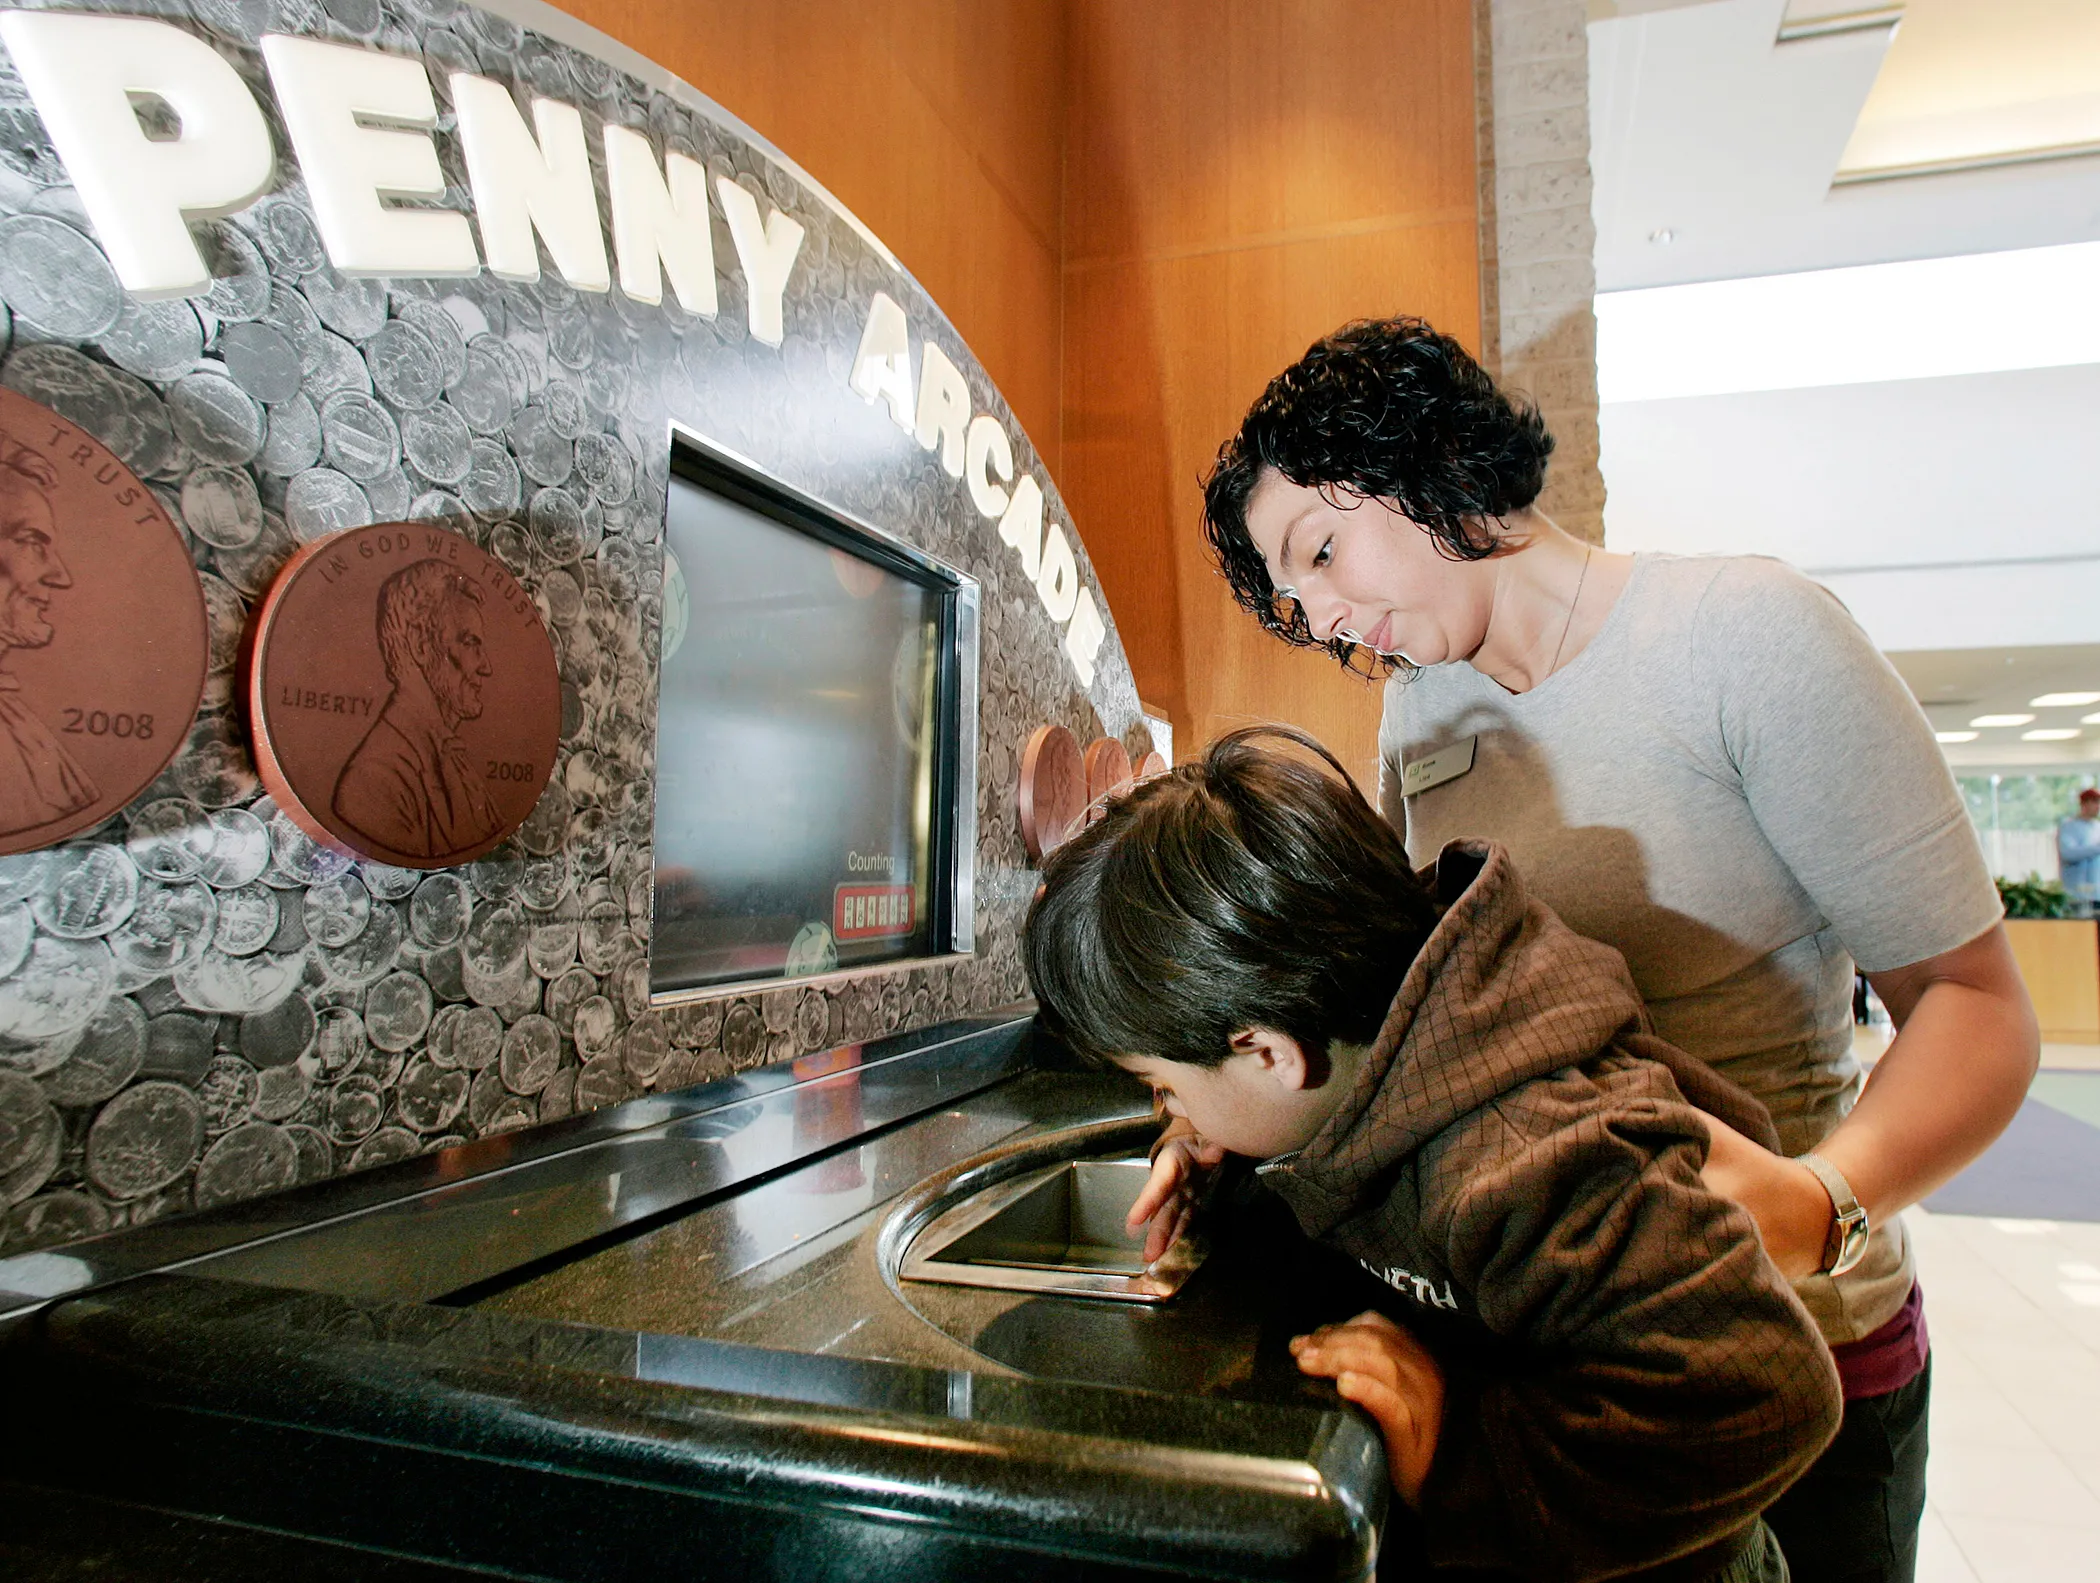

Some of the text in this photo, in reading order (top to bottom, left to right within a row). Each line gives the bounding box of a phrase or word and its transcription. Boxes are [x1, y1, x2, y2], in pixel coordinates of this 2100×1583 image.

[2, 9, 1106, 688] PENNY ARCADE
[48, 423, 160, 525] TRUST
[318, 533, 539, 630] IN GOD WE TRUST
[280, 685, 374, 717] LIBERTY
[61, 707, 154, 740] 2008
[485, 760, 534, 783] 2008
[848, 850, 895, 876] Counting
